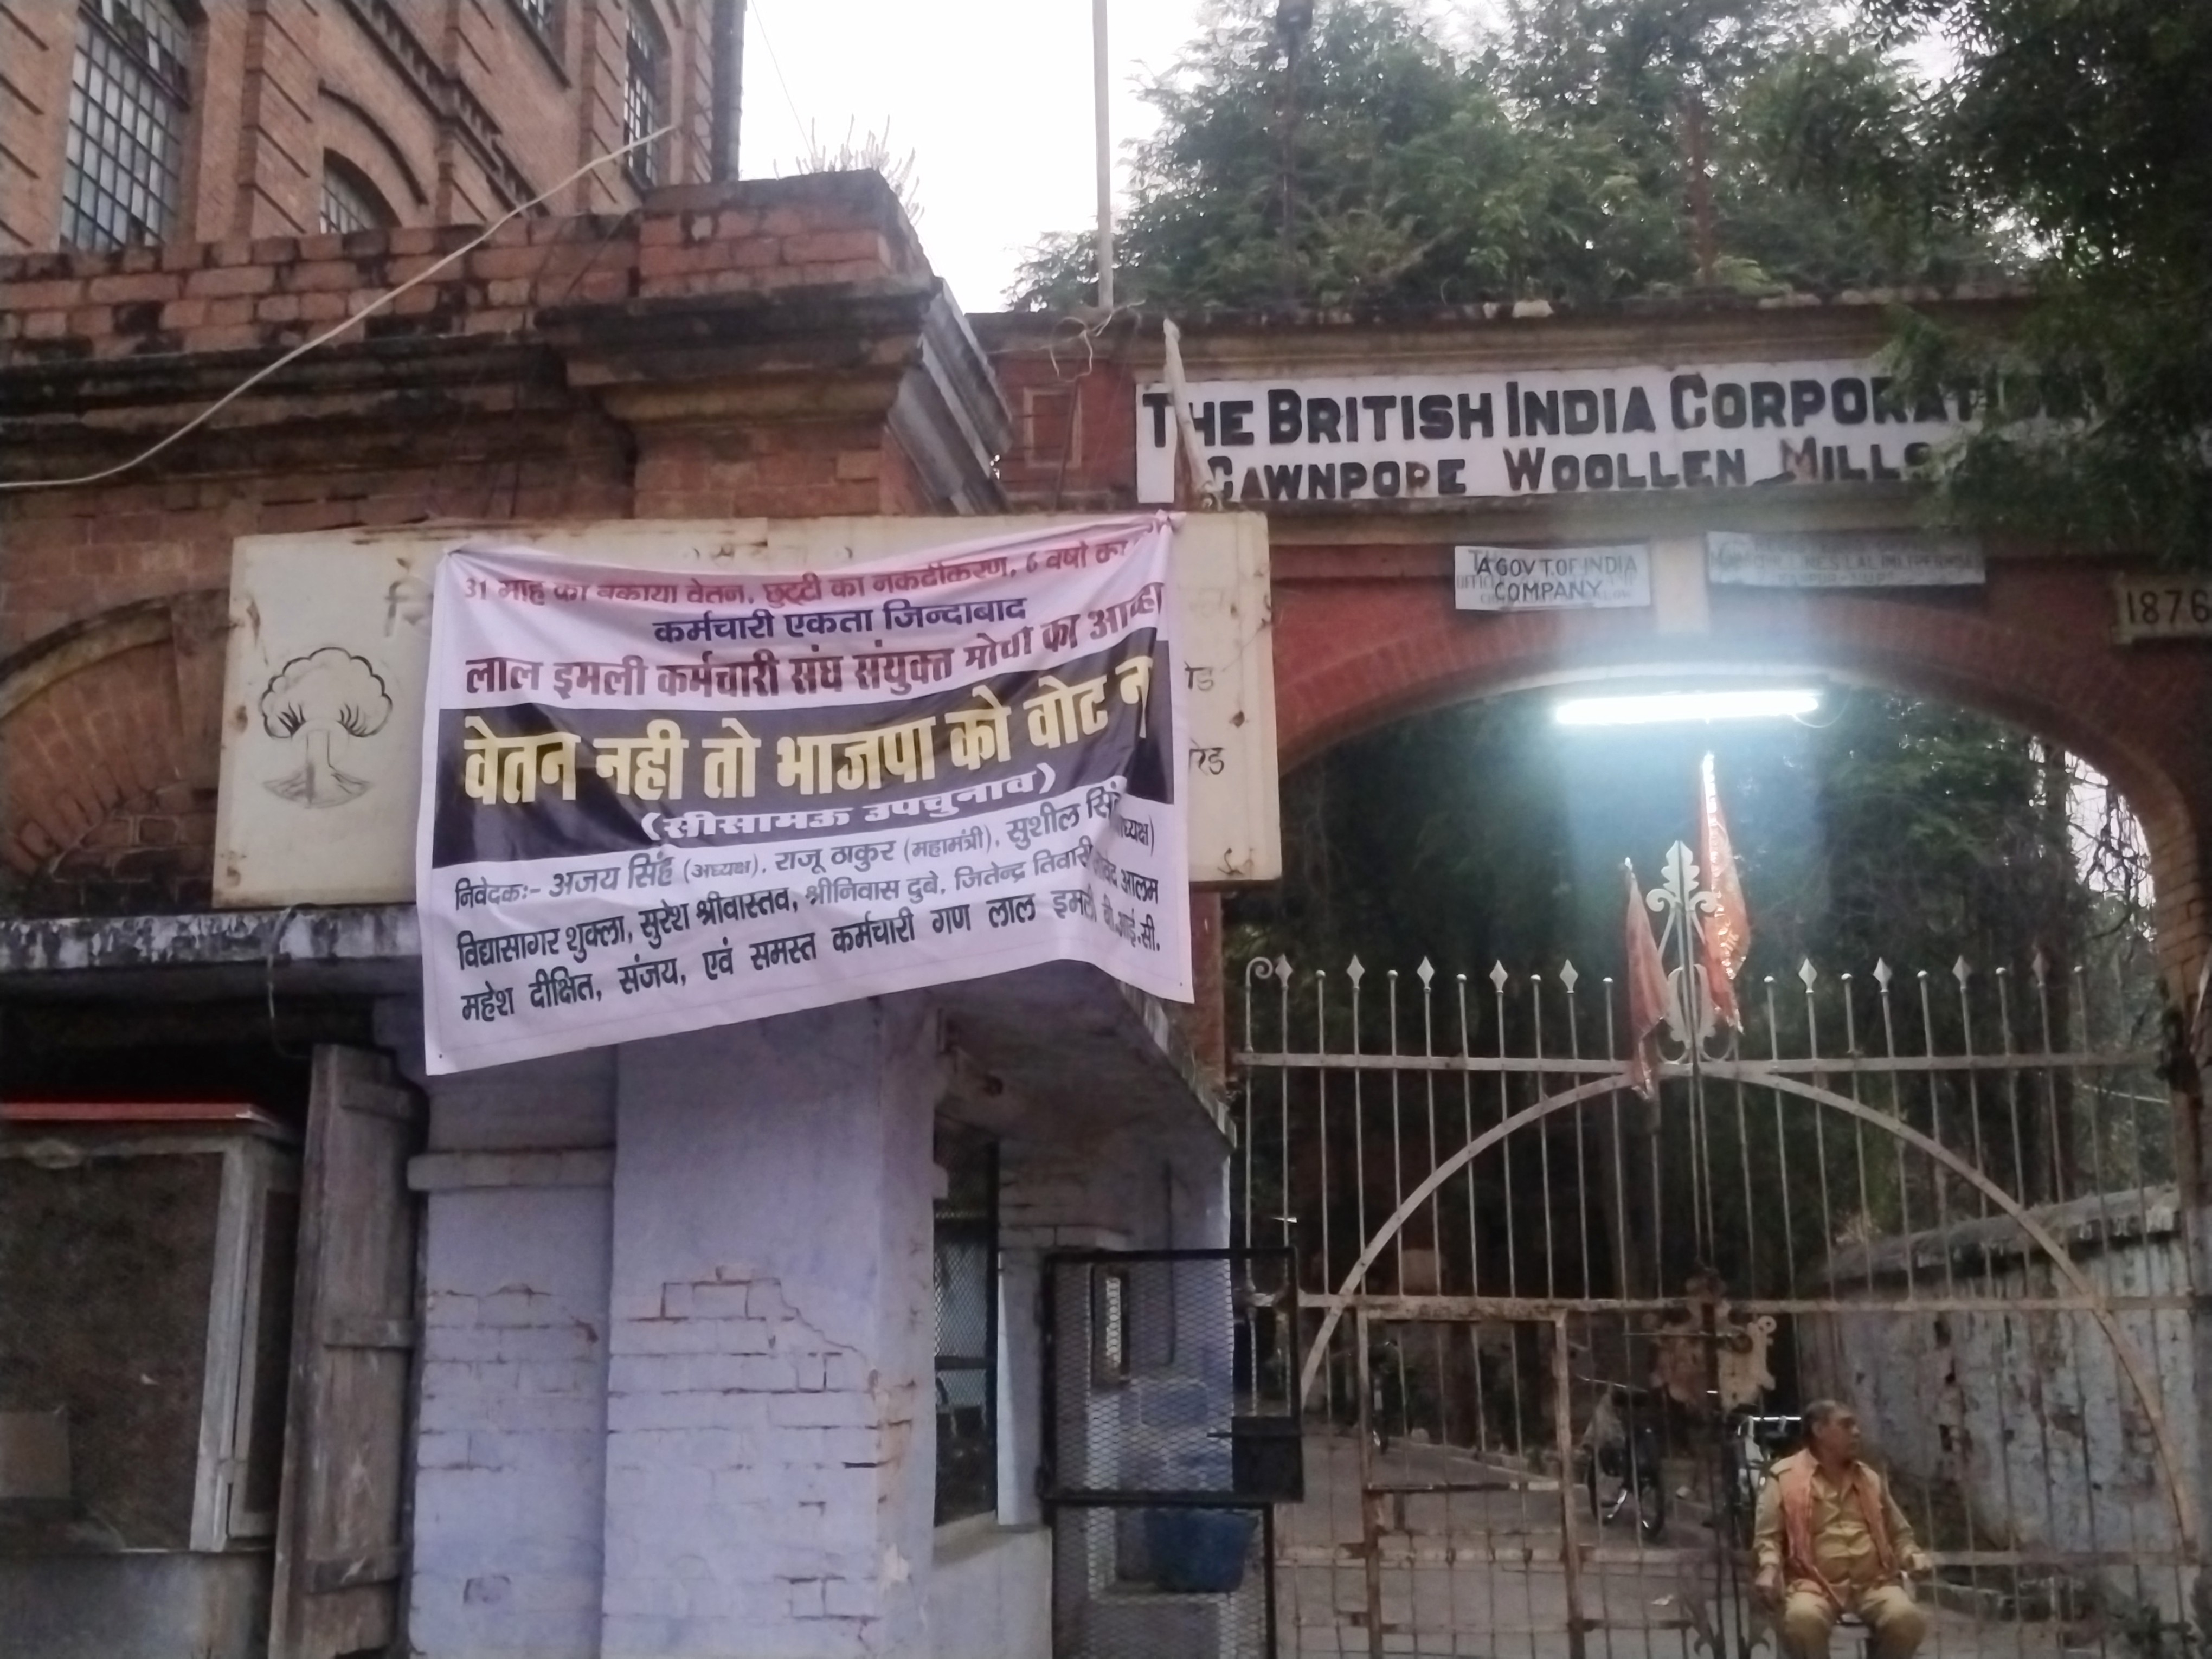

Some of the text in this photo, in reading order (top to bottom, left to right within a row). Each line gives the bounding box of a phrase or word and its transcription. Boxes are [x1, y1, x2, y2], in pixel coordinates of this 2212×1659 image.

[1143, 393, 1254, 448] THE
[1268, 388, 1494, 445] BRITISH
[1506, 381, 1656, 436] INDIA
[1207, 455, 1466, 501] CAWNPORE
[1503, 447, 1746, 491] WOOLLEN
[466, 577, 487, 600] 31
[499, 578, 545, 606] माह
[554, 582, 589, 602] का
[597, 584, 678, 604] बकाया
[829, 576, 865, 597] का
[1026, 552, 1038, 573] 6
[1495, 580, 1603, 602] COMPANY
[1584, 555, 1638, 574] INDIA
[653, 597, 1027, 643] कर्मचारी एकता जिन्दाबाद
[2126, 589, 2210, 625] 1876
[465, 656, 544, 694] लाल
[553, 654, 649, 700] इमली
[656, 648, 780, 698] कर्मचारी
[789, 644, 844, 696] संघ
[853, 639, 955, 696] संयुक्त
[1040, 614, 1081, 652] का
[464, 716, 581, 805] वेतन
[593, 719, 690, 801] नही
[701, 717, 762, 799] तो
[776, 715, 937, 796] भाजपा
[944, 684, 1011, 771] को
[1023, 674, 1109, 749] वोट
[861, 762, 1056, 822] उपचुनाव)
[548, 866, 621, 899] अजय
[627, 851, 676, 890] सिंह
[774, 848, 827, 874] राजू
[831, 840, 897, 871] ठाकुर
[1006, 801, 1080, 851] सुशील
[458, 927, 560, 970] विद्यासागर
[565, 915, 633, 963] शुक्ला,
[639, 899, 690, 949] सुरेश
[696, 886, 798, 926] श्रीवास्तव,
[805, 876, 901, 906] श्रीनिवास
[907, 870, 946, 904] दुबे,
[954, 859, 1026, 893] जितेन्द्र
[1033, 834, 1094, 877] तिवारी
[1121, 868, 1159, 905] आलम
[461, 981, 515, 1022] महेश
[529, 965, 602, 1009] दीक्षित,
[617, 953, 687, 995] संजय,
[702, 937, 734, 981] एवं
[748, 931, 818, 971] समस्त
[831, 906, 916, 954] कर्मचारी
[930, 903, 972, 935] गण
[986, 892, 1037, 929] लाल
